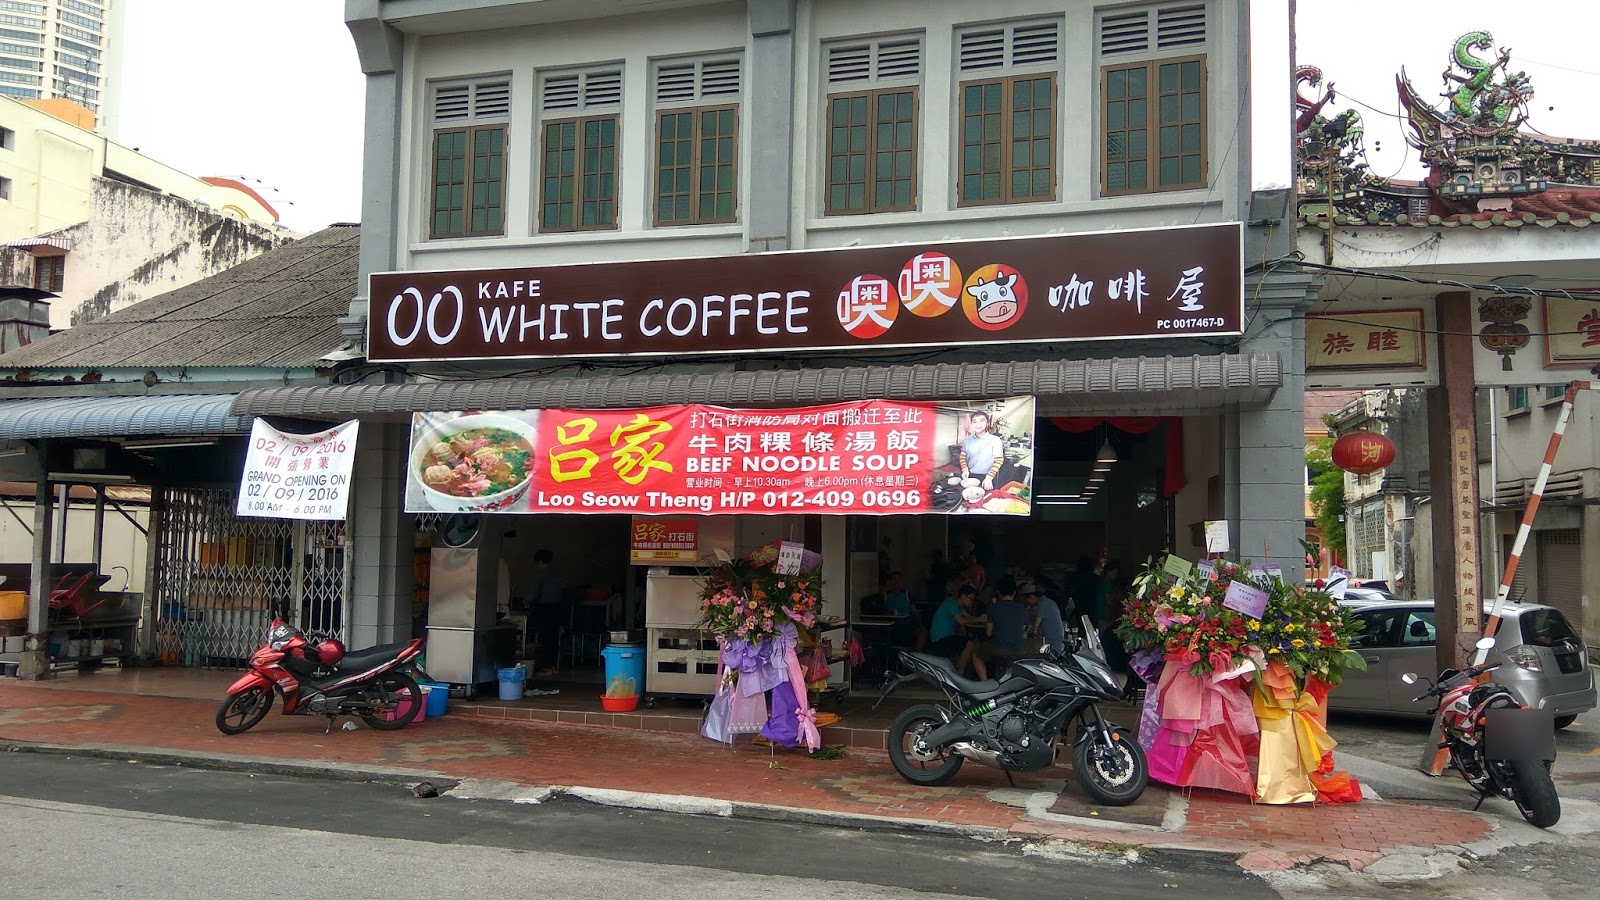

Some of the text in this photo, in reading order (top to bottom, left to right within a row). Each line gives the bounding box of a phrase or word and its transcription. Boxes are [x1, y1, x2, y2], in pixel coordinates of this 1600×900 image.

[478, 280, 541, 299] KAFE
[1048, 266, 1206, 314] 咖啡屋
[478, 299, 624, 343] WHITE
[640, 290, 811, 337] COFFEE
[1157, 318, 1225, 329] PC 0017467-D
[256, 438, 277, 453] 02
[292, 446, 309, 457] 09
[316, 440, 346, 455] 2016
[686, 454, 919, 473] BEEF NOODLE SOUP
[247, 471, 346, 487] GRAND OPENING ON
[247, 483, 261, 497] 02
[275, 487, 295, 500] 09
[308, 487, 339, 501] 2016
[538, 490, 921, 510] Loo Seow Theng H/P 012-409 0696
[247, 501, 265, 511] 8.00
[267, 502, 283, 512] AM
[293, 505, 316, 514] 6.00
[318, 505, 332, 514] PM
